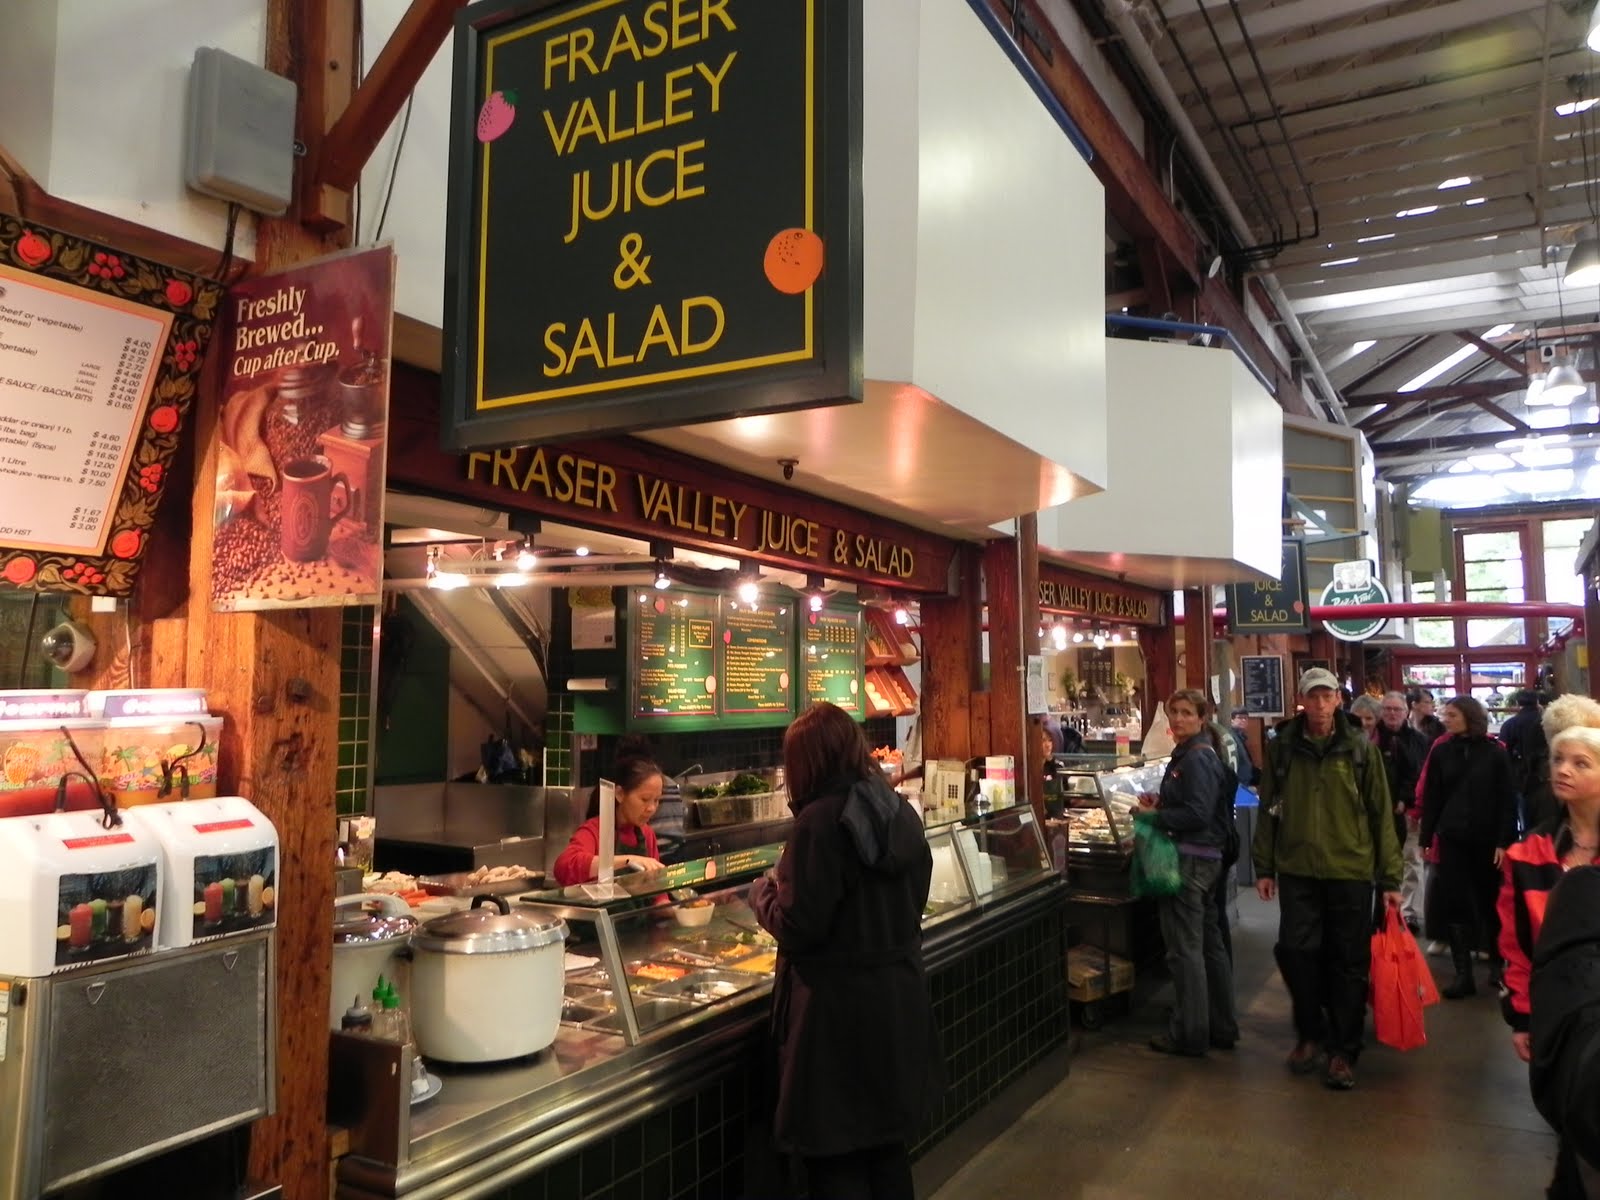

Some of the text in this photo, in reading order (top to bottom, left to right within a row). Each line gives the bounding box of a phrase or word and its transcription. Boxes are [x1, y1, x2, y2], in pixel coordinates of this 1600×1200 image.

[544, 0, 738, 90] FRASER
[542, 51, 739, 158] VALLEY
[564, 139, 706, 244] JUICE
[613, 232, 652, 290] &
[237, 286, 307, 323] Freshly
[37, 316, 83, 332] vegetable)
[235, 313, 324, 352] Brewed...
[543, 295, 725, 377] SALAD
[233, 356, 262, 379] Cup
[263, 346, 302, 371] after
[6, 378, 37, 391] SAUCE
[42, 386, 74, 398] BACON
[75, 392, 93, 402] BITS
[468, 448, 914, 578] FRASER VALLEY JUICE & SALAD
[1059, 584, 1092, 611] VALLEY
[1095, 592, 1114, 615] JUICE
[1125, 597, 1149, 618] SALAD
[1254, 580, 1282, 594] JUICE
[1264, 594, 1273, 607] &
[1251, 609, 1288, 622] SALAD
